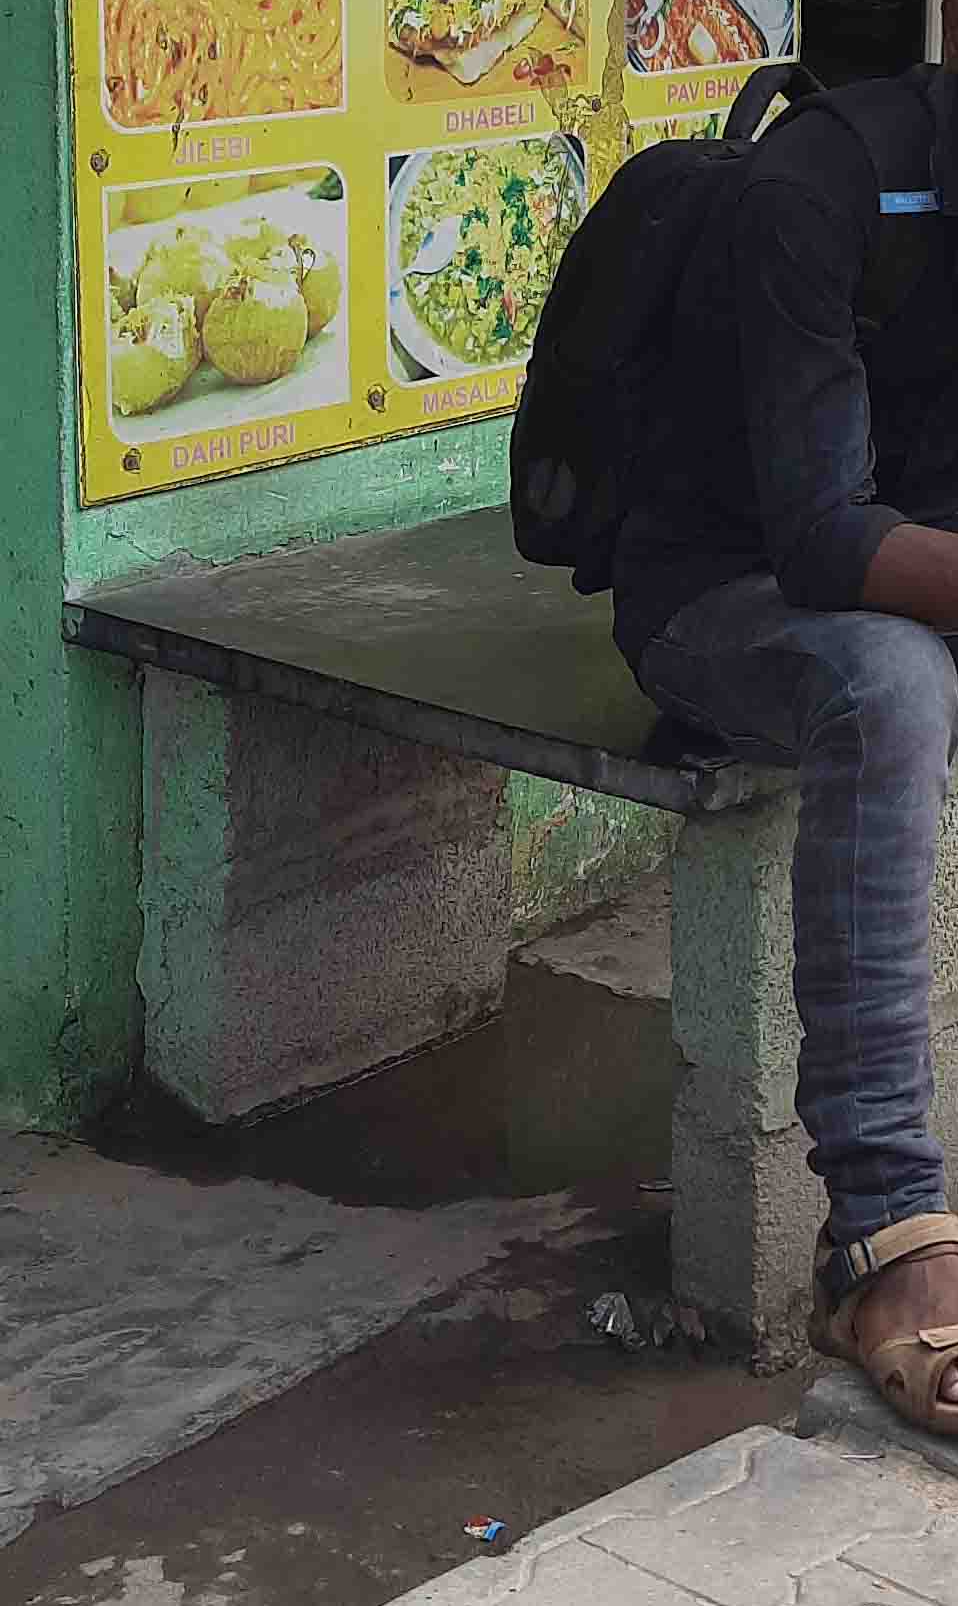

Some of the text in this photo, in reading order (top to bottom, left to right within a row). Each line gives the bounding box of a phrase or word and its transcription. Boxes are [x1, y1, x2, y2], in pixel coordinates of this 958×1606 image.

[667, 75, 741, 105] PAV BHA
[446, 101, 535, 132] DHABELI
[423, 375, 509, 414] MASALA
[172, 423, 297, 467] DAHI PURI
